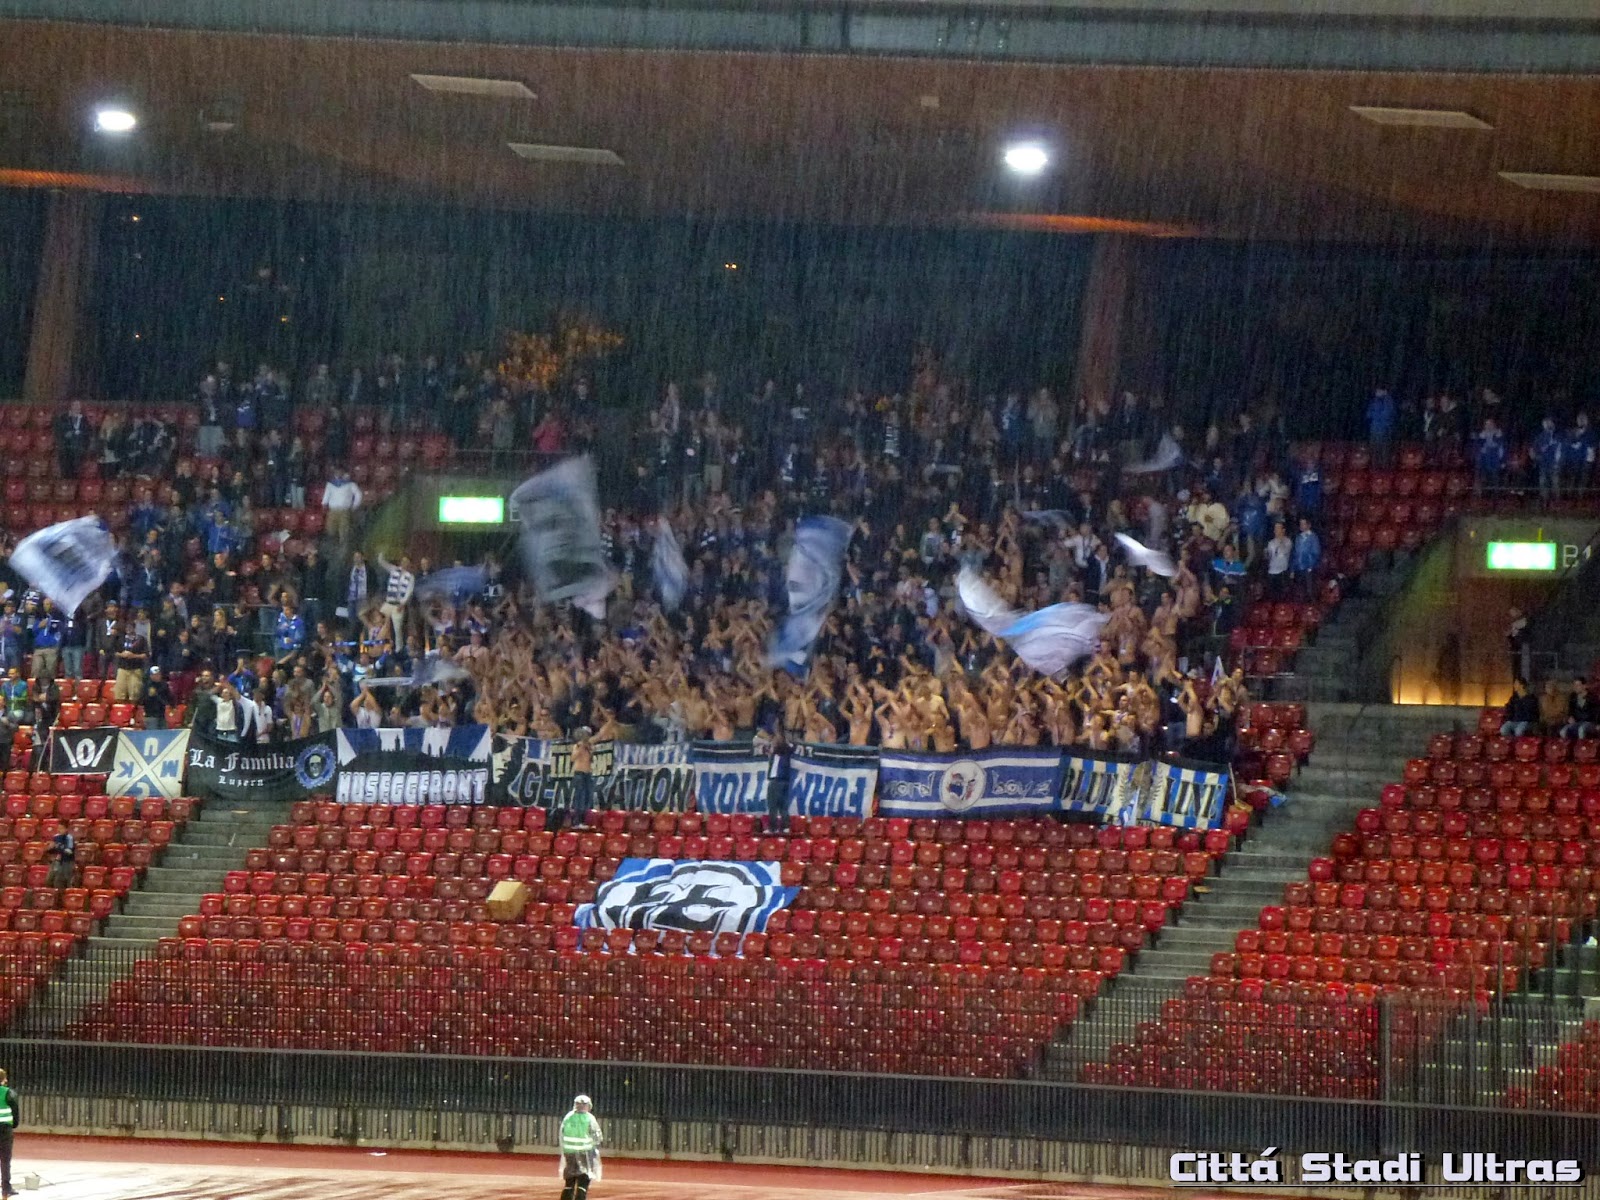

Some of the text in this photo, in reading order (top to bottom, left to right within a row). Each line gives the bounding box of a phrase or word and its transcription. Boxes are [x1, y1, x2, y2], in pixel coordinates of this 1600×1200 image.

[189, 748, 295, 773] La Familia
[218, 775, 264, 787] Luzern
[337, 769, 488, 804] MUSEGGFRONT
[697, 769, 868, 818] FORMTION
